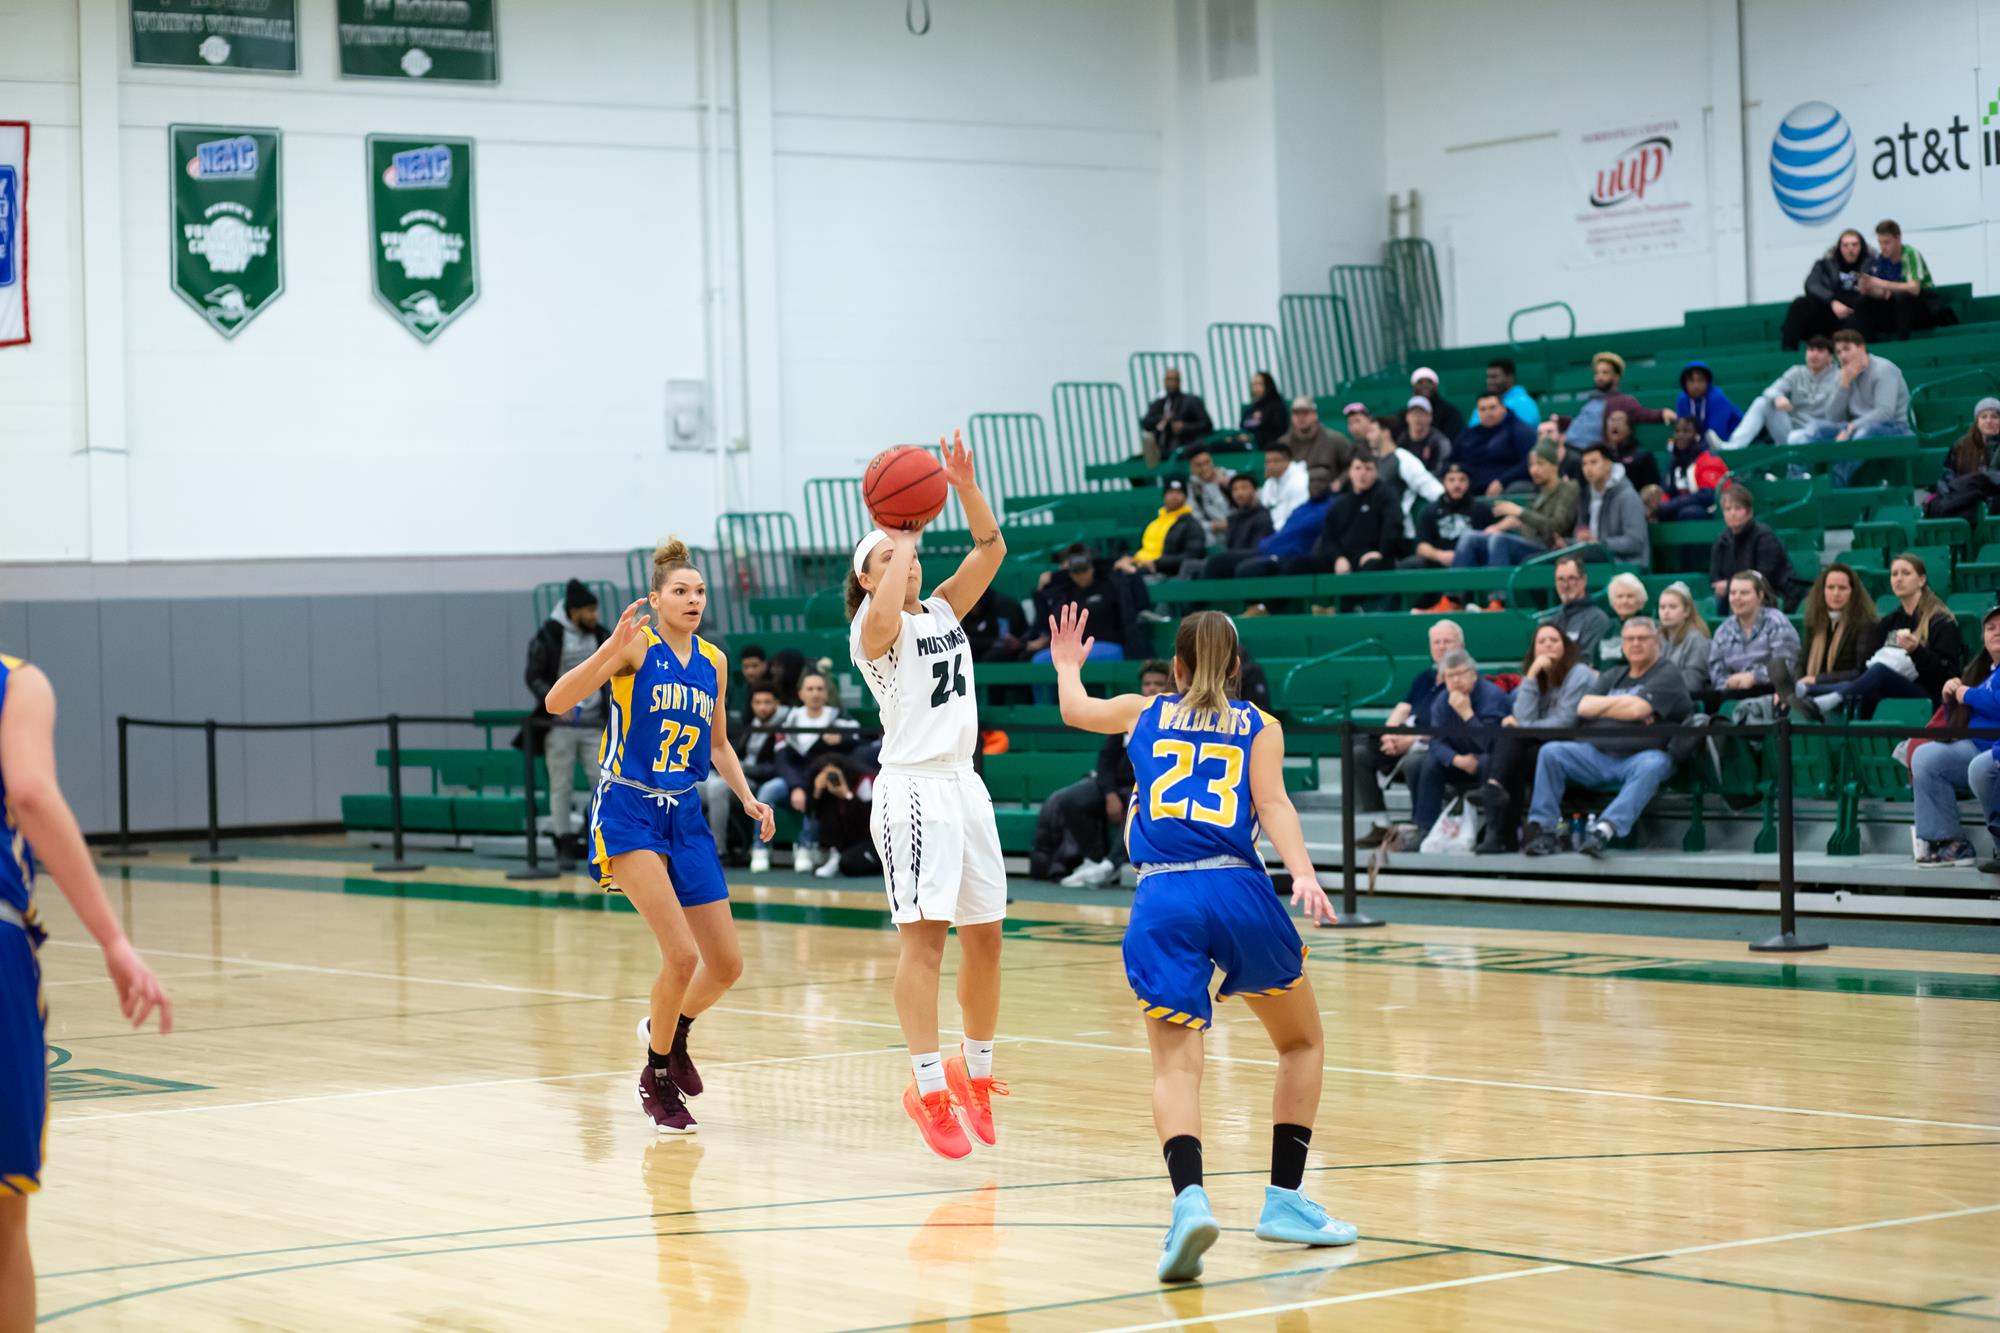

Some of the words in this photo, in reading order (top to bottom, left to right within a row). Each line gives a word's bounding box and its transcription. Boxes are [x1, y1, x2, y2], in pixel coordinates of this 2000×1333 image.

[1596, 146, 1664, 200] uup
[1872, 115, 1970, 180] at&t
[652, 718, 701, 772] 33
[1158, 701, 1251, 735] WILDCATS
[1150, 739, 1244, 828] 23
